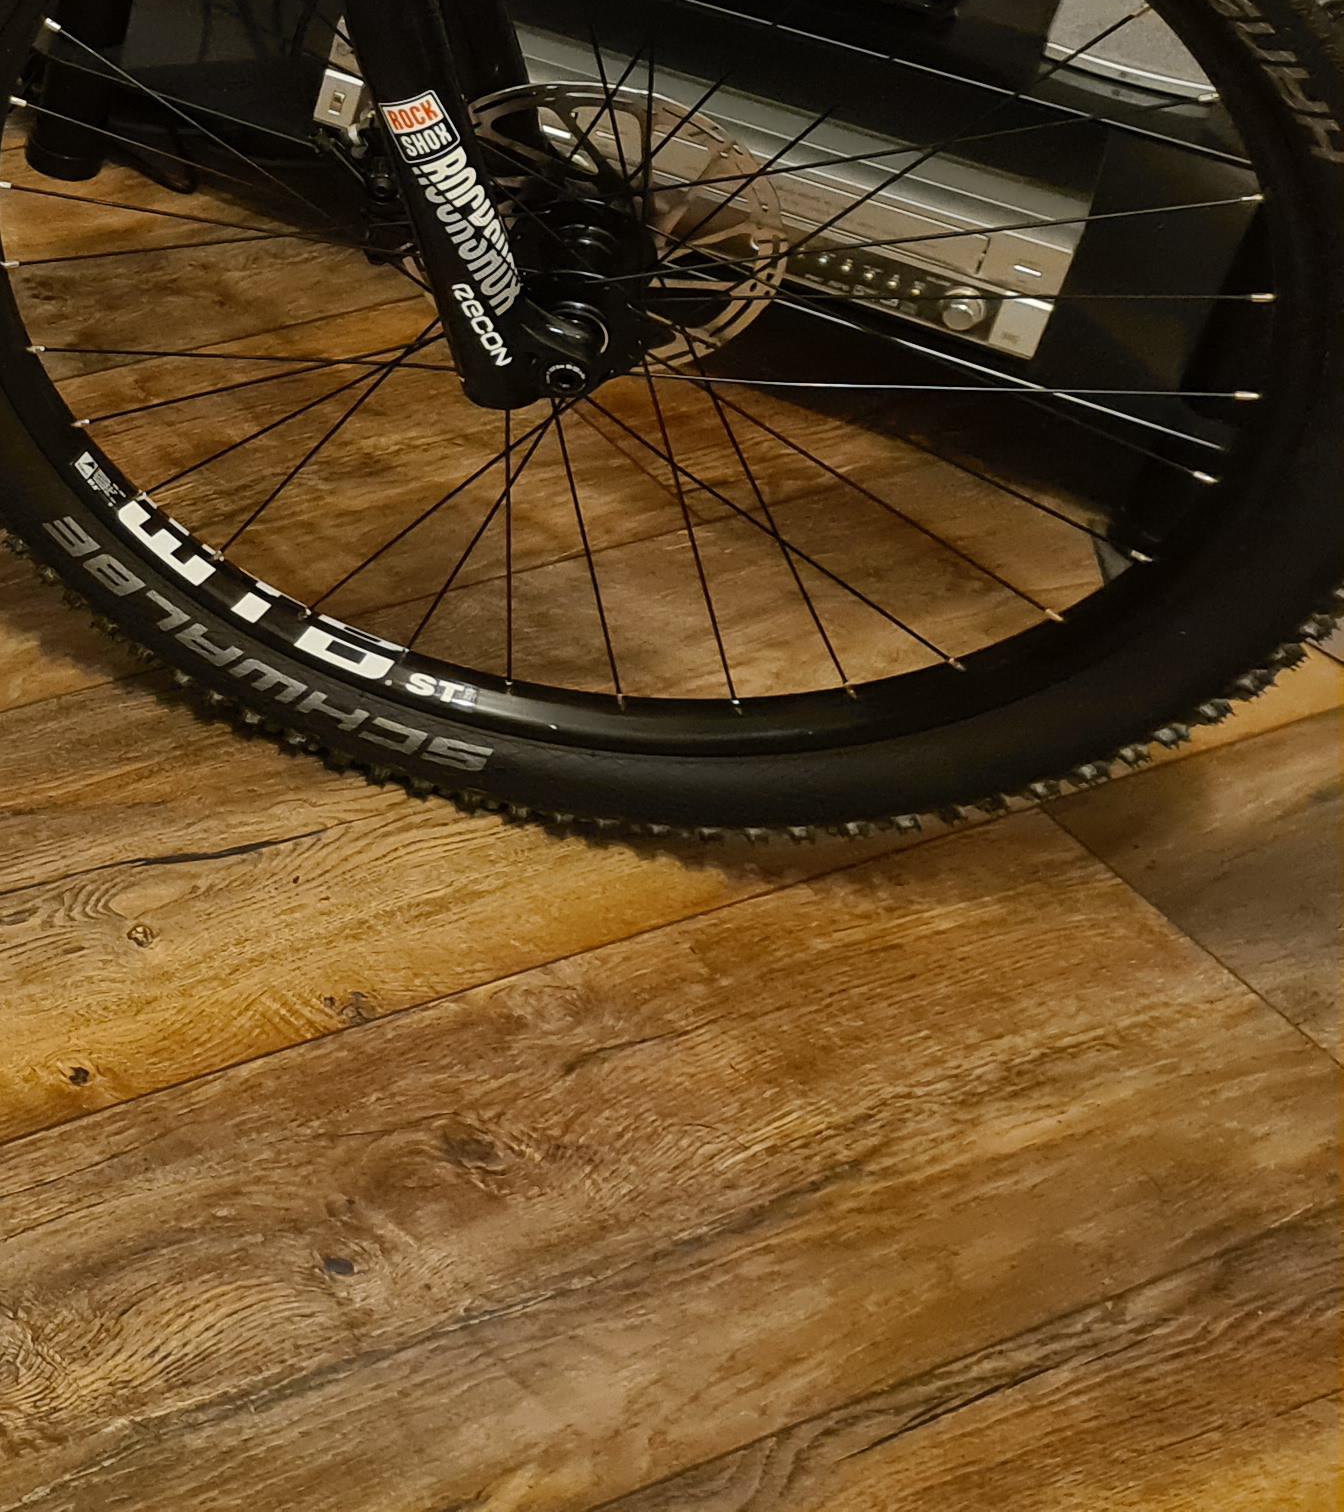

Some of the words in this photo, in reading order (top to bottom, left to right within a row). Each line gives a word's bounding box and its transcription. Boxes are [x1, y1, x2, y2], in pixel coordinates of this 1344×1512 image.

[386, 98, 441, 133] ROCK
[400, 122, 453, 159] SHOX
[41, 514, 496, 773] SCHWALBE
